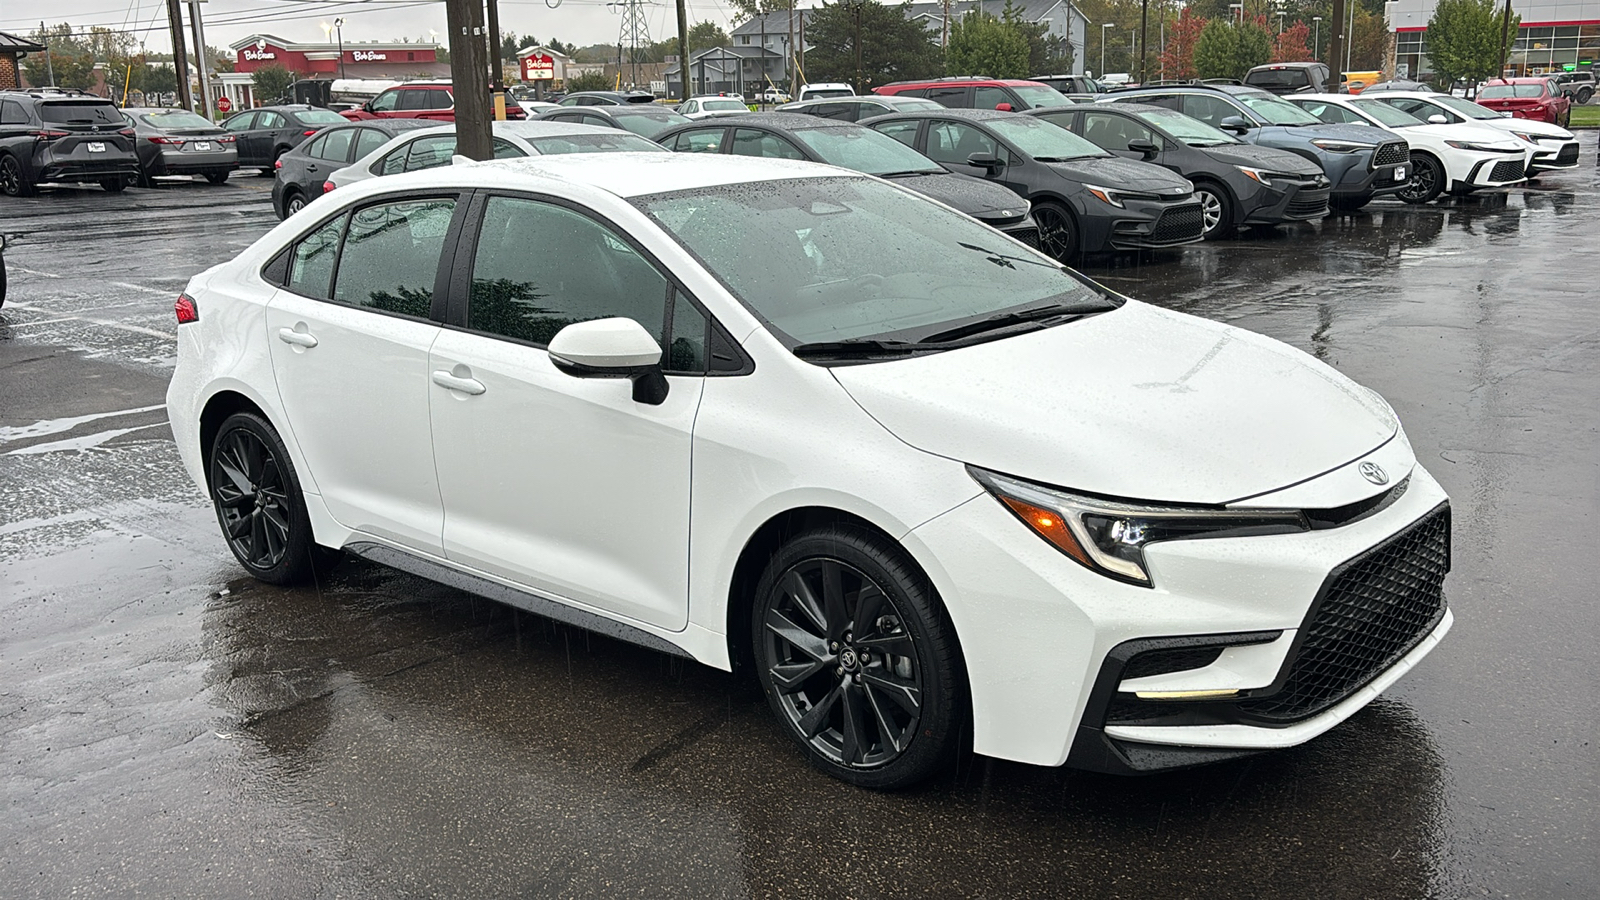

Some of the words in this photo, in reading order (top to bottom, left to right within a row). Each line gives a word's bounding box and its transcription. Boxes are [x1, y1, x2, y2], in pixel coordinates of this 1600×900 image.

[243, 50, 257, 60] Bob
[257, 50, 275, 60] Evans
[352, 51, 367, 61] Bob
[367, 51, 386, 61] Evans
